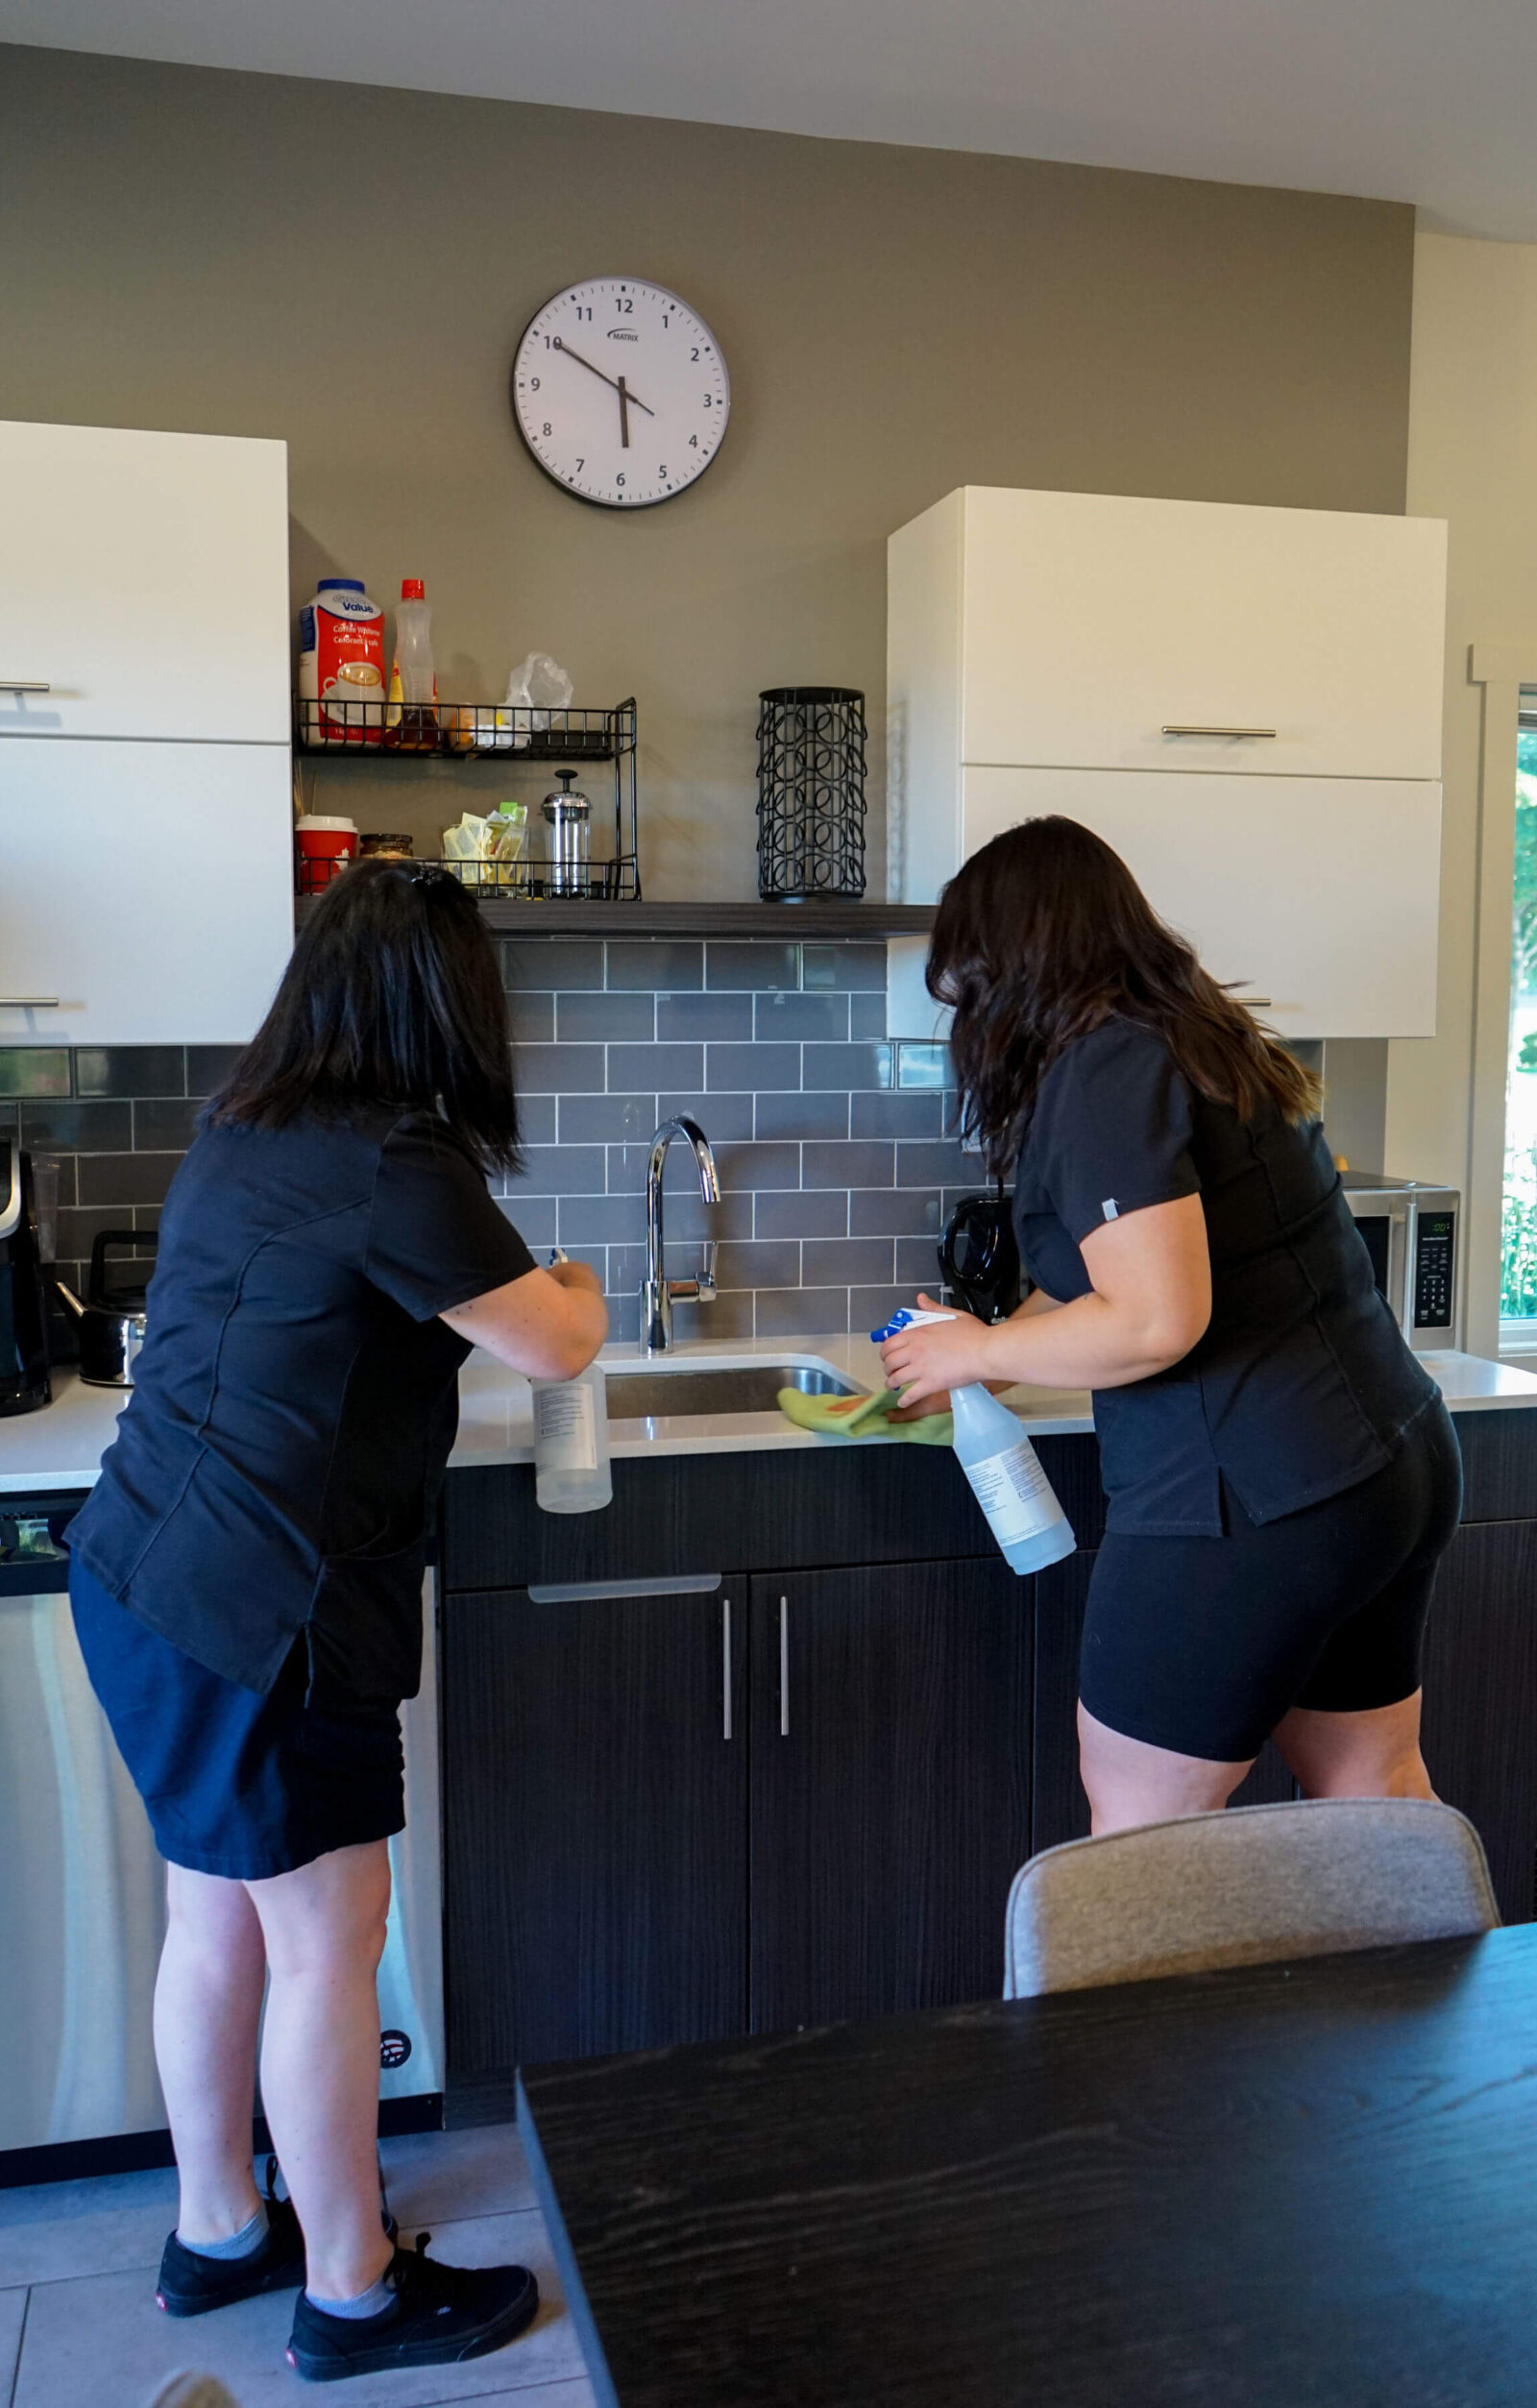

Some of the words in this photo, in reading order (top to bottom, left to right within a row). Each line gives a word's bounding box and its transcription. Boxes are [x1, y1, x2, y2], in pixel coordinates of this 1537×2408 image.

[615, 299, 634, 313] 12
[575, 306, 593, 321] 11
[662, 315, 669, 328] 1
[544, 335, 563, 350] 10
[613, 332, 638, 342] MATRIX
[691, 348, 699, 362] 2
[531, 377, 541, 392] 9
[703, 394, 712, 408] 3
[543, 423, 552, 437] 8
[689, 434, 698, 449] 4
[576, 458, 585, 473] 7
[658, 465, 668, 478] 5
[616, 473, 625, 487] 6
[343, 601, 374, 614] Value
